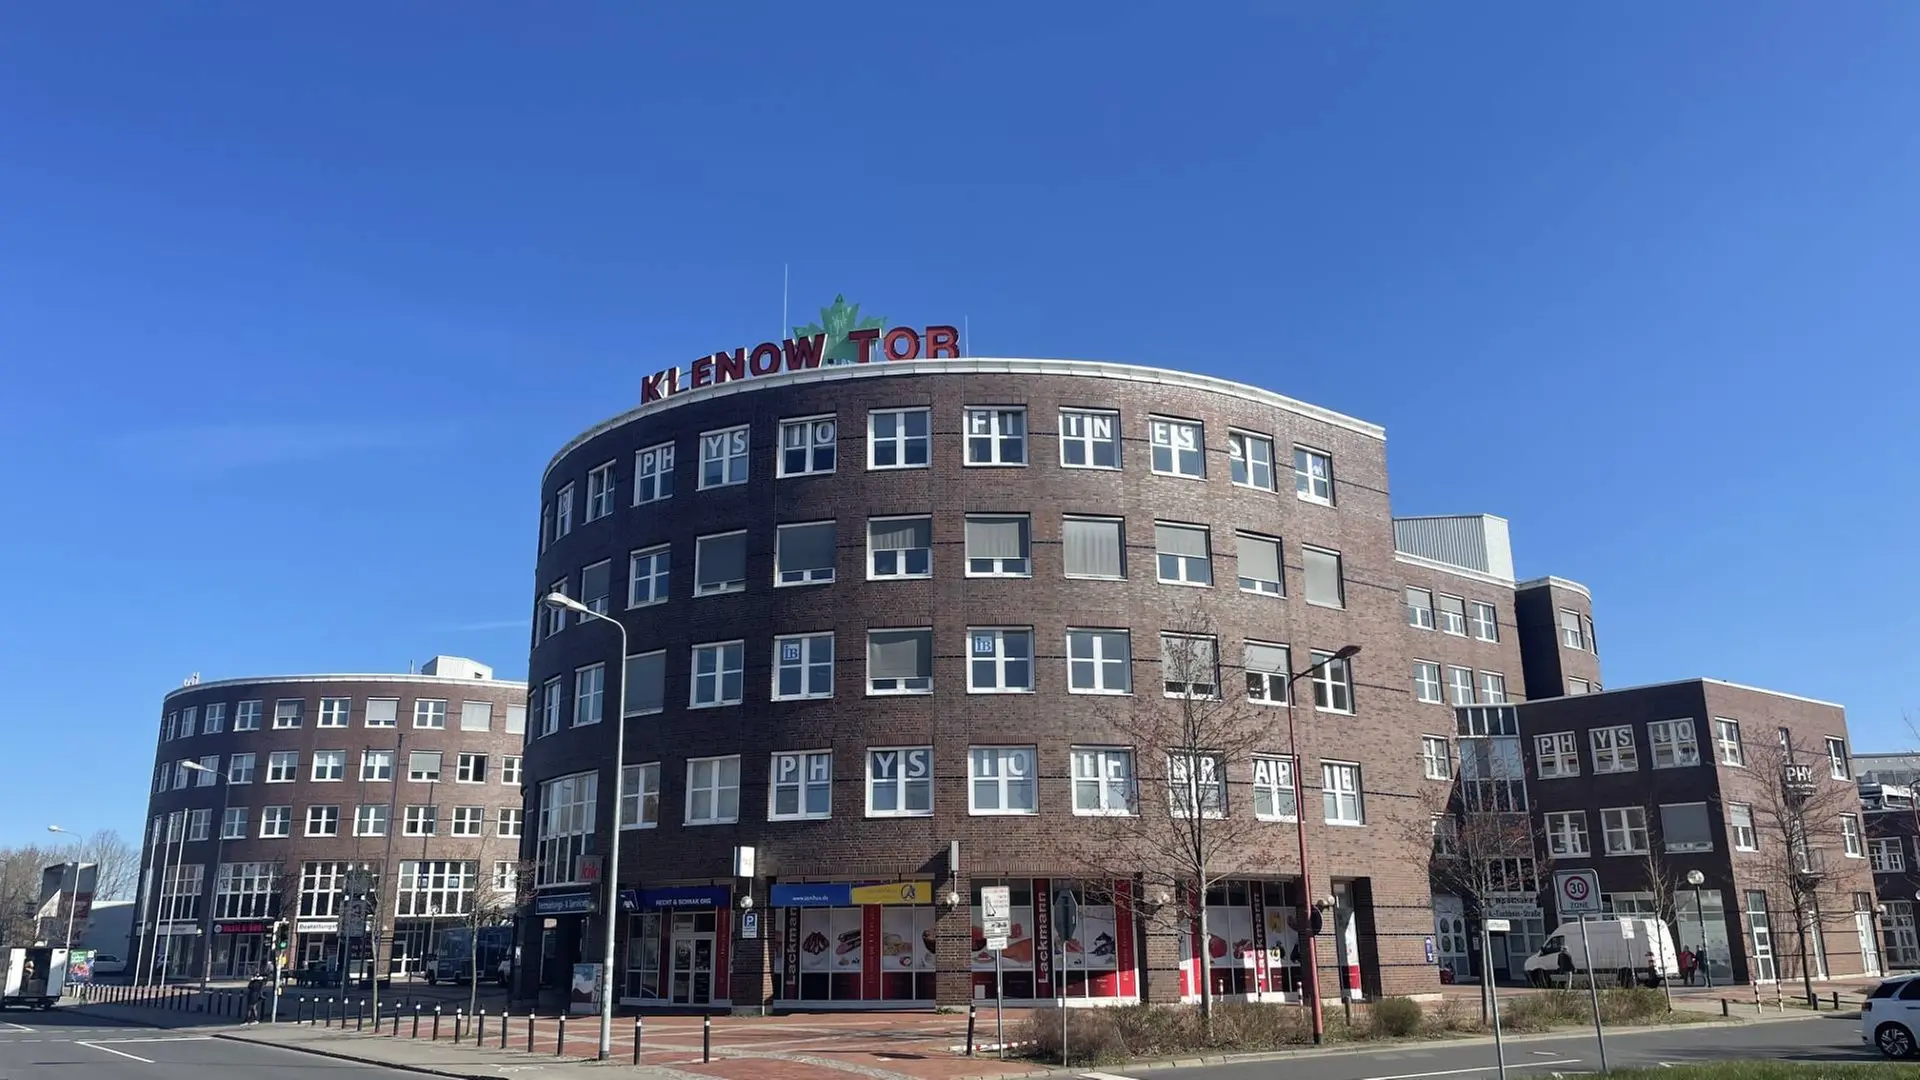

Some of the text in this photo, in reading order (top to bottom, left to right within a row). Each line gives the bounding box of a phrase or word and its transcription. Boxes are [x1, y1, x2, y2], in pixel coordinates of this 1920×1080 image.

[641, 325, 959, 404] KLENOW TOR
[1570, 882, 1585, 894] 30
[1037, 892, 1049, 984] Lackmann
